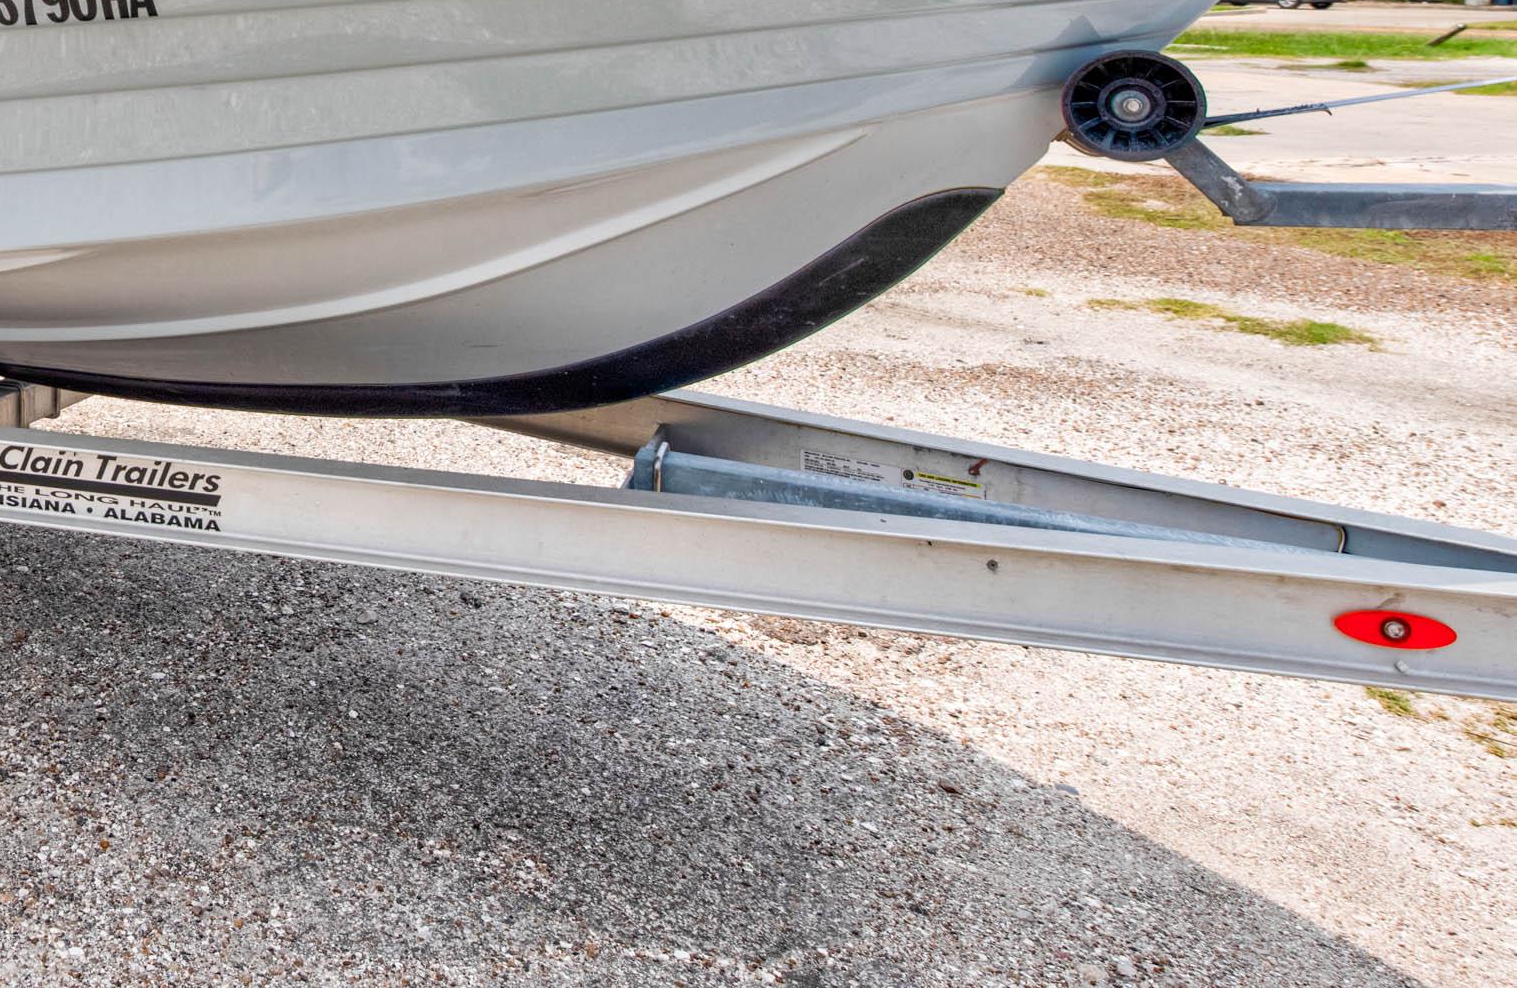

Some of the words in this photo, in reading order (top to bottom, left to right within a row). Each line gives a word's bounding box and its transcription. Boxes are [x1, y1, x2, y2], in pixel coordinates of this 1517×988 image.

[96, 455, 222, 493] Trailers
[34, 488, 119, 505] LONG
[103, 507, 222, 532] ALABAMA
